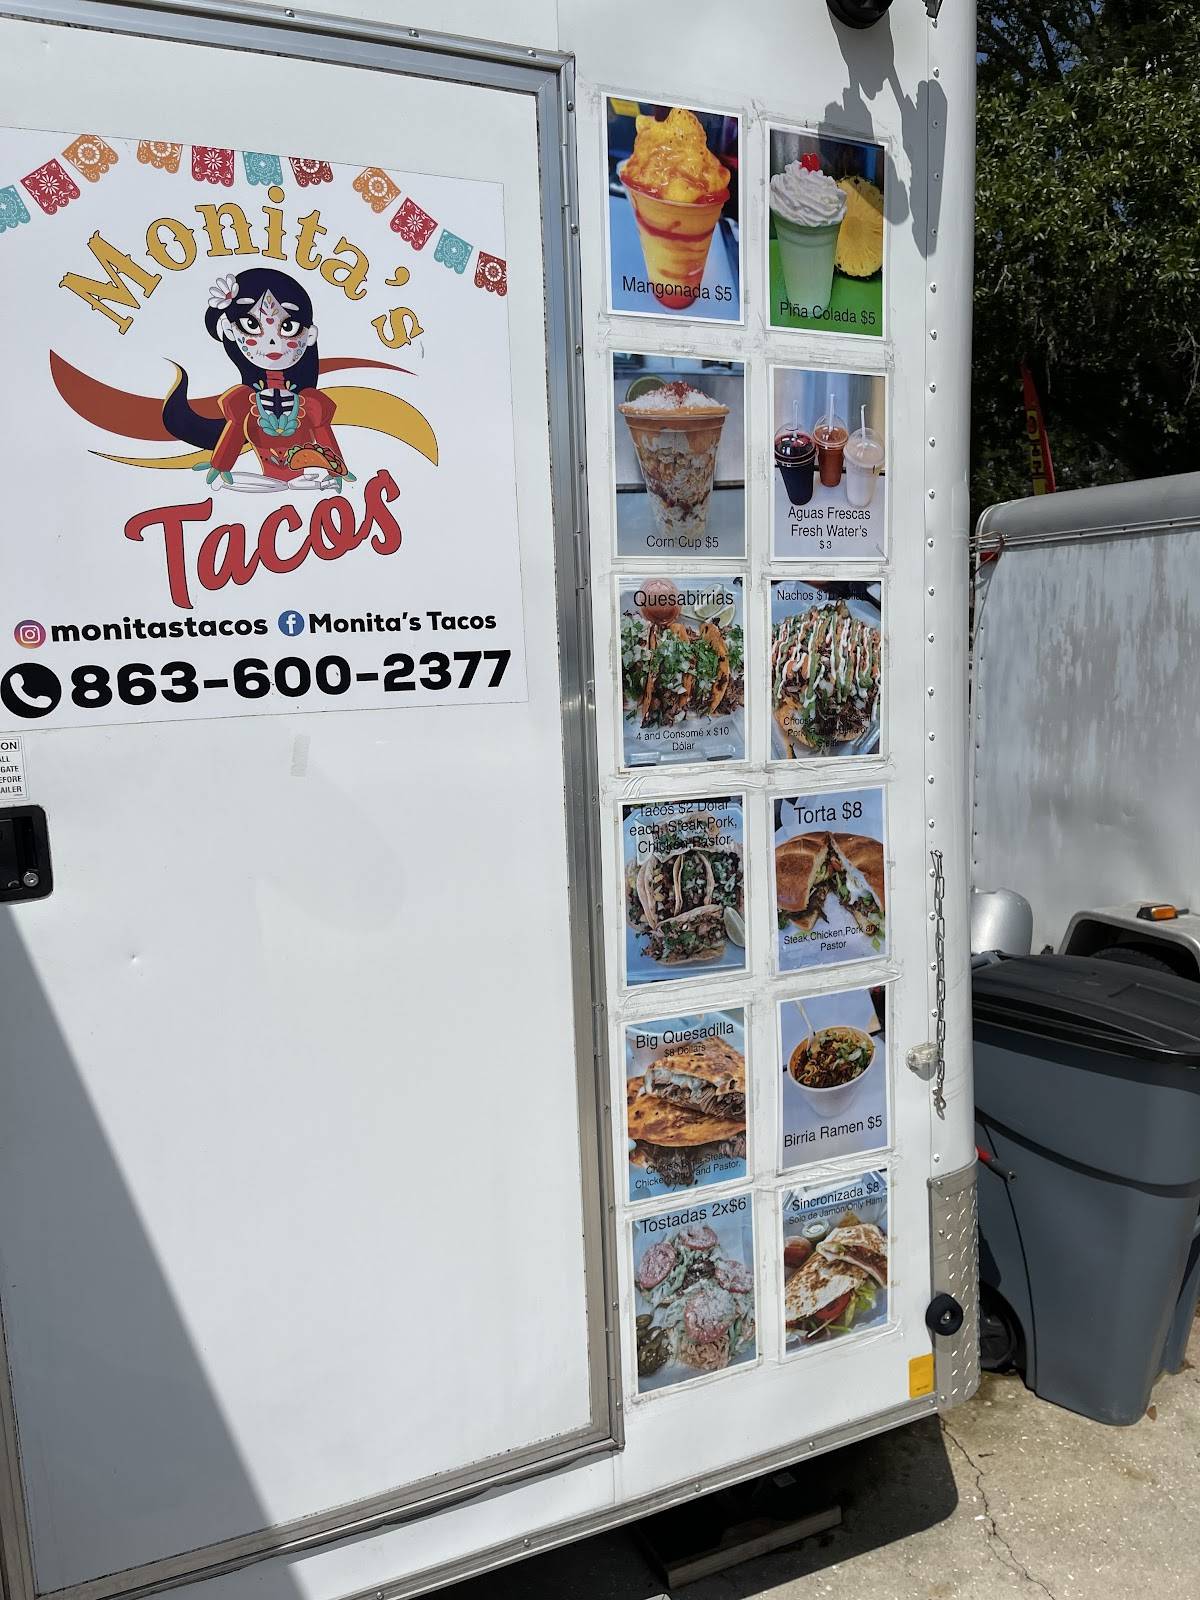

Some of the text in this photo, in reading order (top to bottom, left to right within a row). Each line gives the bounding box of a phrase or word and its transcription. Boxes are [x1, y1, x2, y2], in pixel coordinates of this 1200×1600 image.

[59, 186, 424, 349] Monita's
[622, 276, 733, 302] Mangonada $5
[780, 302, 876, 325] Piña Colada $5
[788, 506, 871, 521] Aguas Frescas
[124, 469, 402, 610] Tacos
[646, 535, 719, 551] Corn Cup $5
[791, 525, 868, 538] Fresh Water's
[633, 590, 734, 608] Quesabirrias
[777, 589, 814, 601] Nachos
[51, 616, 268, 642] monitastacos
[309, 611, 497, 634] Monita's Tacos
[69, 649, 512, 709] 863-600-2377
[636, 732, 643, 741] 4
[644, 732, 661, 741] and
[706, 729, 712, 737] x
[713, 727, 730, 737] $10
[639, 805, 675, 817] Tacos
[678, 802, 694, 815] $2
[794, 801, 862, 825] Torta $8
[636, 1021, 735, 1050] Big Quesadilla
[784, 1114, 883, 1148] Birria Ramen $5
[695, 1166, 711, 1176] and
[792, 1181, 880, 1212] Sincronizada $8
[640, 1198, 747, 1234] Tostadas 2x$6
[788, 1215, 806, 1225] Solo
[807, 1211, 818, 1220] de
